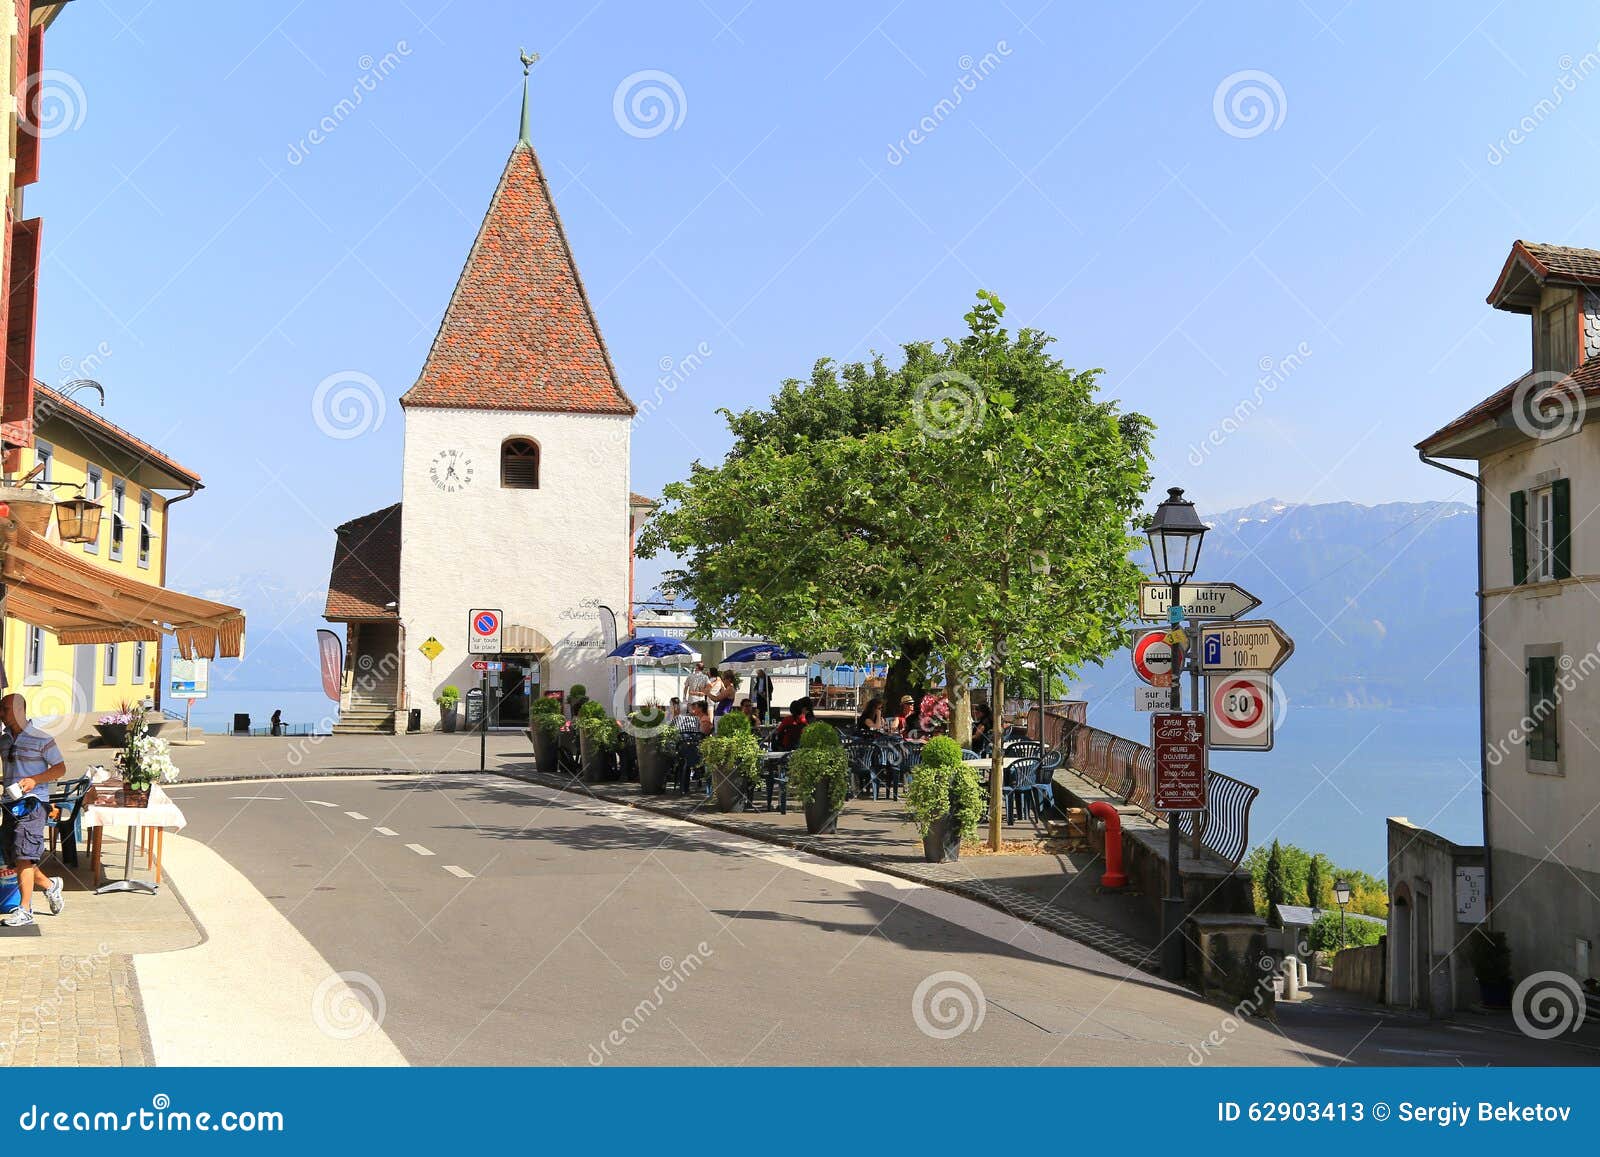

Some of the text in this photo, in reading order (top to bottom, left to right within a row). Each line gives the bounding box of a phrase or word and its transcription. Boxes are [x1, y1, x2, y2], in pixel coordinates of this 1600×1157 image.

[1151, 588, 1226, 604] Cull Lutry
[1160, 601, 1216, 613] Lsanne
[1222, 631, 1231, 647] Le
[1233, 630, 1269, 650] Bougnon
[1233, 651, 1258, 667] 100 m
[1147, 700, 1170, 710] place
[1229, 695, 1249, 713] 30
